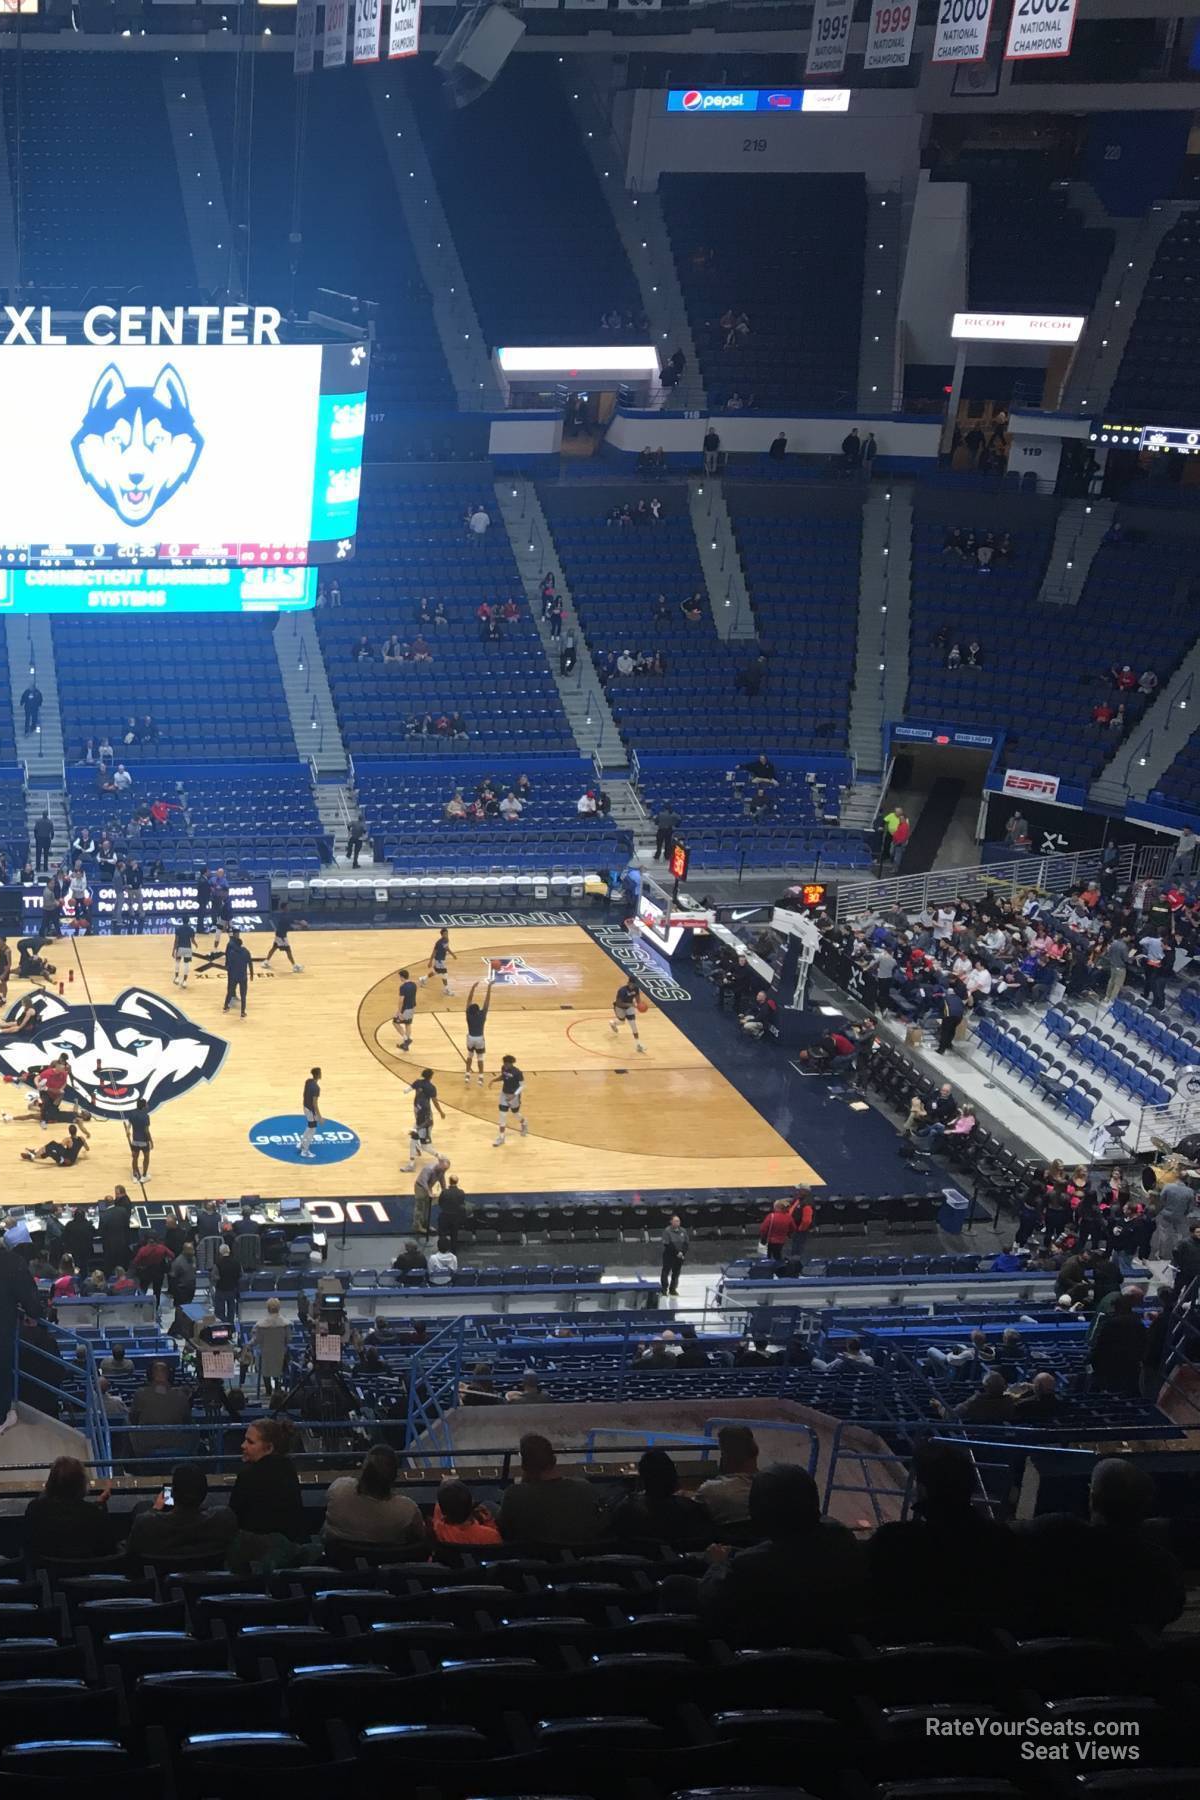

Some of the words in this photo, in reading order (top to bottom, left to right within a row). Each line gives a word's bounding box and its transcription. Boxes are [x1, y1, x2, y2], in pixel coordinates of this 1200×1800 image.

[940, 0, 988, 24] 2000
[875, 6, 912, 34] 1999
[817, 15, 849, 41] 1995
[942, 28, 979, 41] NATIONAL
[1019, 21, 1062, 34] NATIONAL
[873, 39, 906, 50] NATIONAL
[937, 44, 980, 58] CHAMPIONS
[1013, 38, 1063, 52] CHAMPIONS
[868, 54, 906, 66] CHAMPIONS
[703, 94, 744, 109] pepsi
[743, 139, 768, 152] 219
[3, 306, 67, 345] XL
[83, 305, 281, 345] CENTER
[964, 318, 1006, 327] RICOH
[1029, 320, 1071, 329] RICOH
[370, 413, 385, 422] 117
[1187, 433, 1198, 445] 0
[1005, 775, 1056, 794] ESPN
[1041, 831, 1069, 850] XL
[155, 901, 174, 910] the
[420, 912, 577, 927] UCONN
[586, 925, 692, 1001] HUSKIES
[250, 1131, 355, 1145] genis3D
